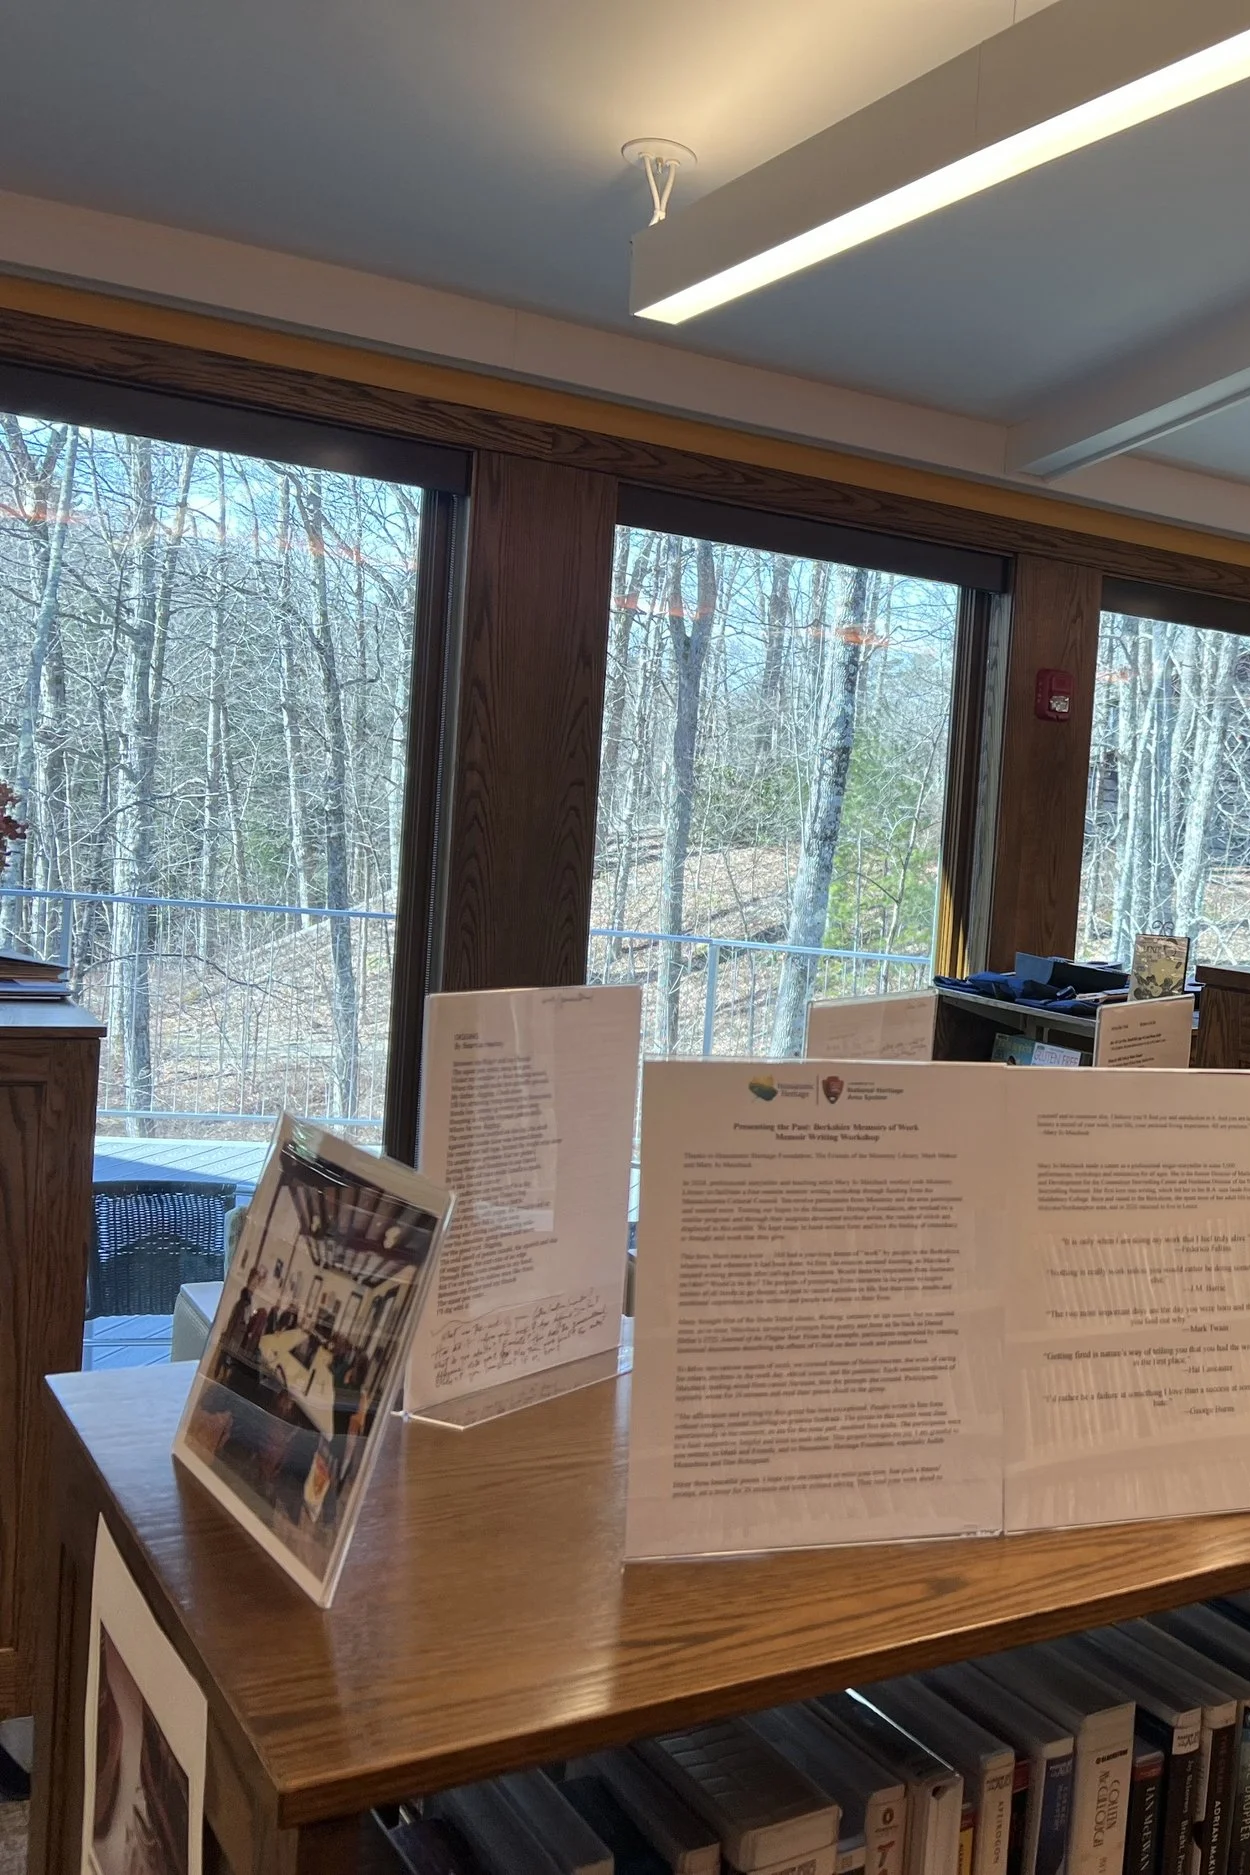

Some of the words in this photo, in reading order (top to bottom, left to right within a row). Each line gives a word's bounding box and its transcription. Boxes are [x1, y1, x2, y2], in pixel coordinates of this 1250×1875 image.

[1035, 1050, 1060, 1064] GLUTEN
[1063, 1055, 1079, 1065] FREE
[1144, 1786, 1156, 1811] IAN
[1211, 1800, 1222, 1843] ADRIAN
[1139, 1814, 1154, 1872] McEWAN
